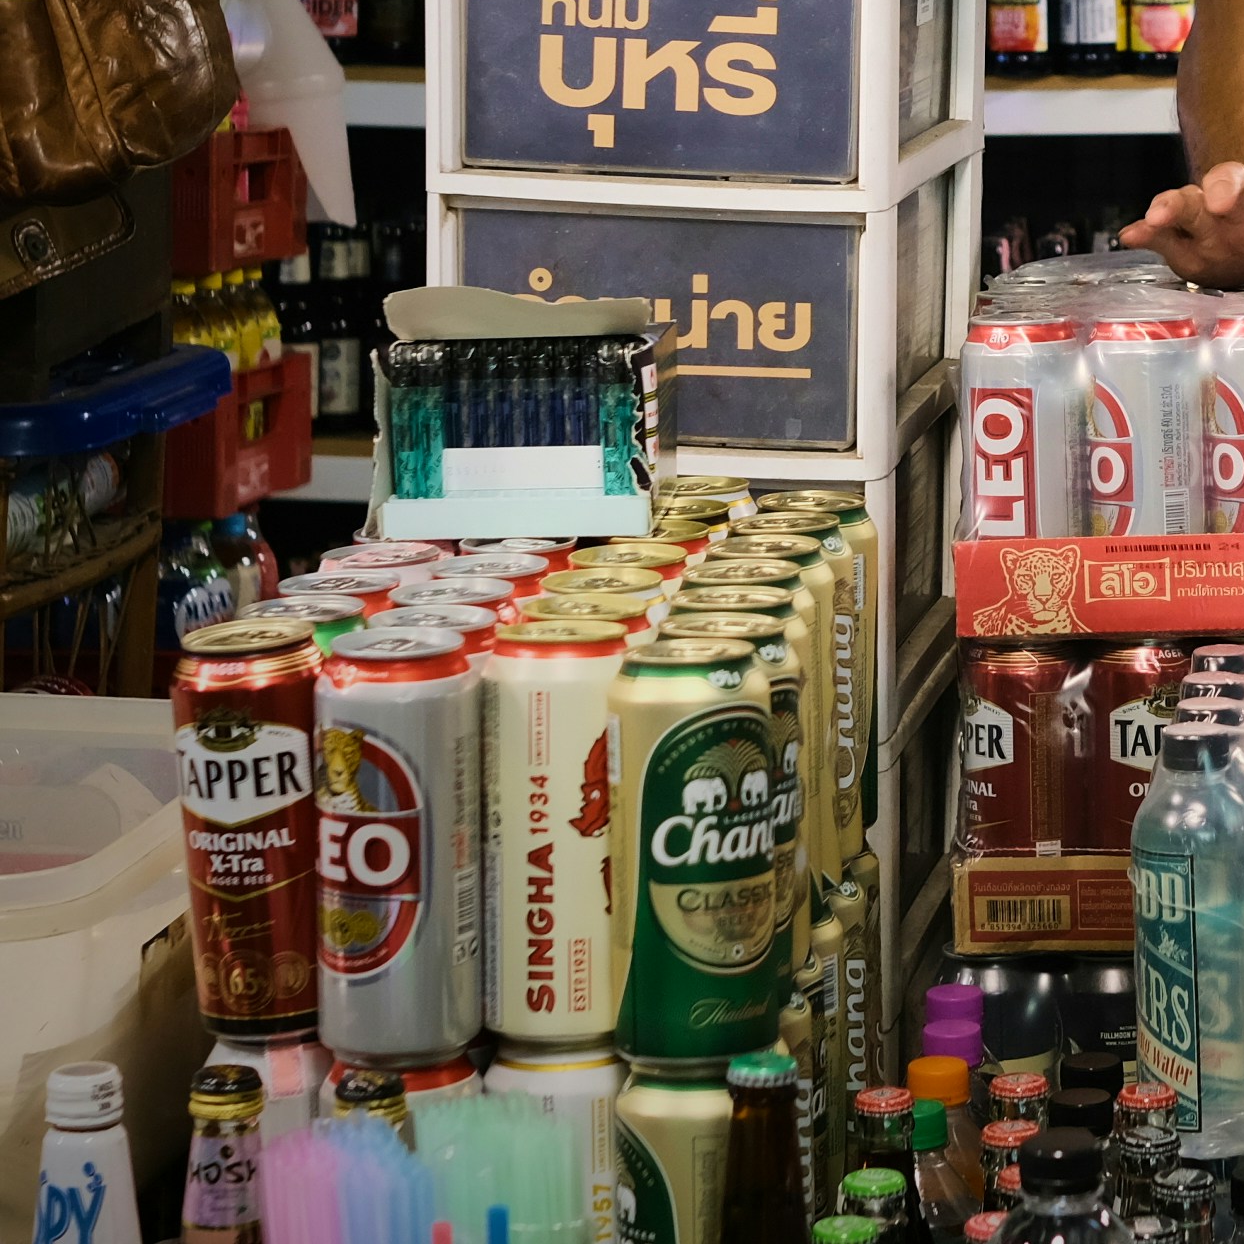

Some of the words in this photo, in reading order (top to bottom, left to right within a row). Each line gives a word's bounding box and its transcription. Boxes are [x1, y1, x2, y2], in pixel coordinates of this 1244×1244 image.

[974, 398, 1026, 537] LEO
[1100, 563, 1158, 598] ลีโอ
[529, 774, 550, 836] 1934
[188, 827, 297, 852] ORIGINAL
[209, 853, 265, 874] X-Tra
[318, 816, 411, 888] EO
[243, 873, 274, 885] BEER
[525, 841, 557, 1014] SINGHA
[1152, 1044, 1194, 1088] water
[592, 1184, 614, 1242] 1957
